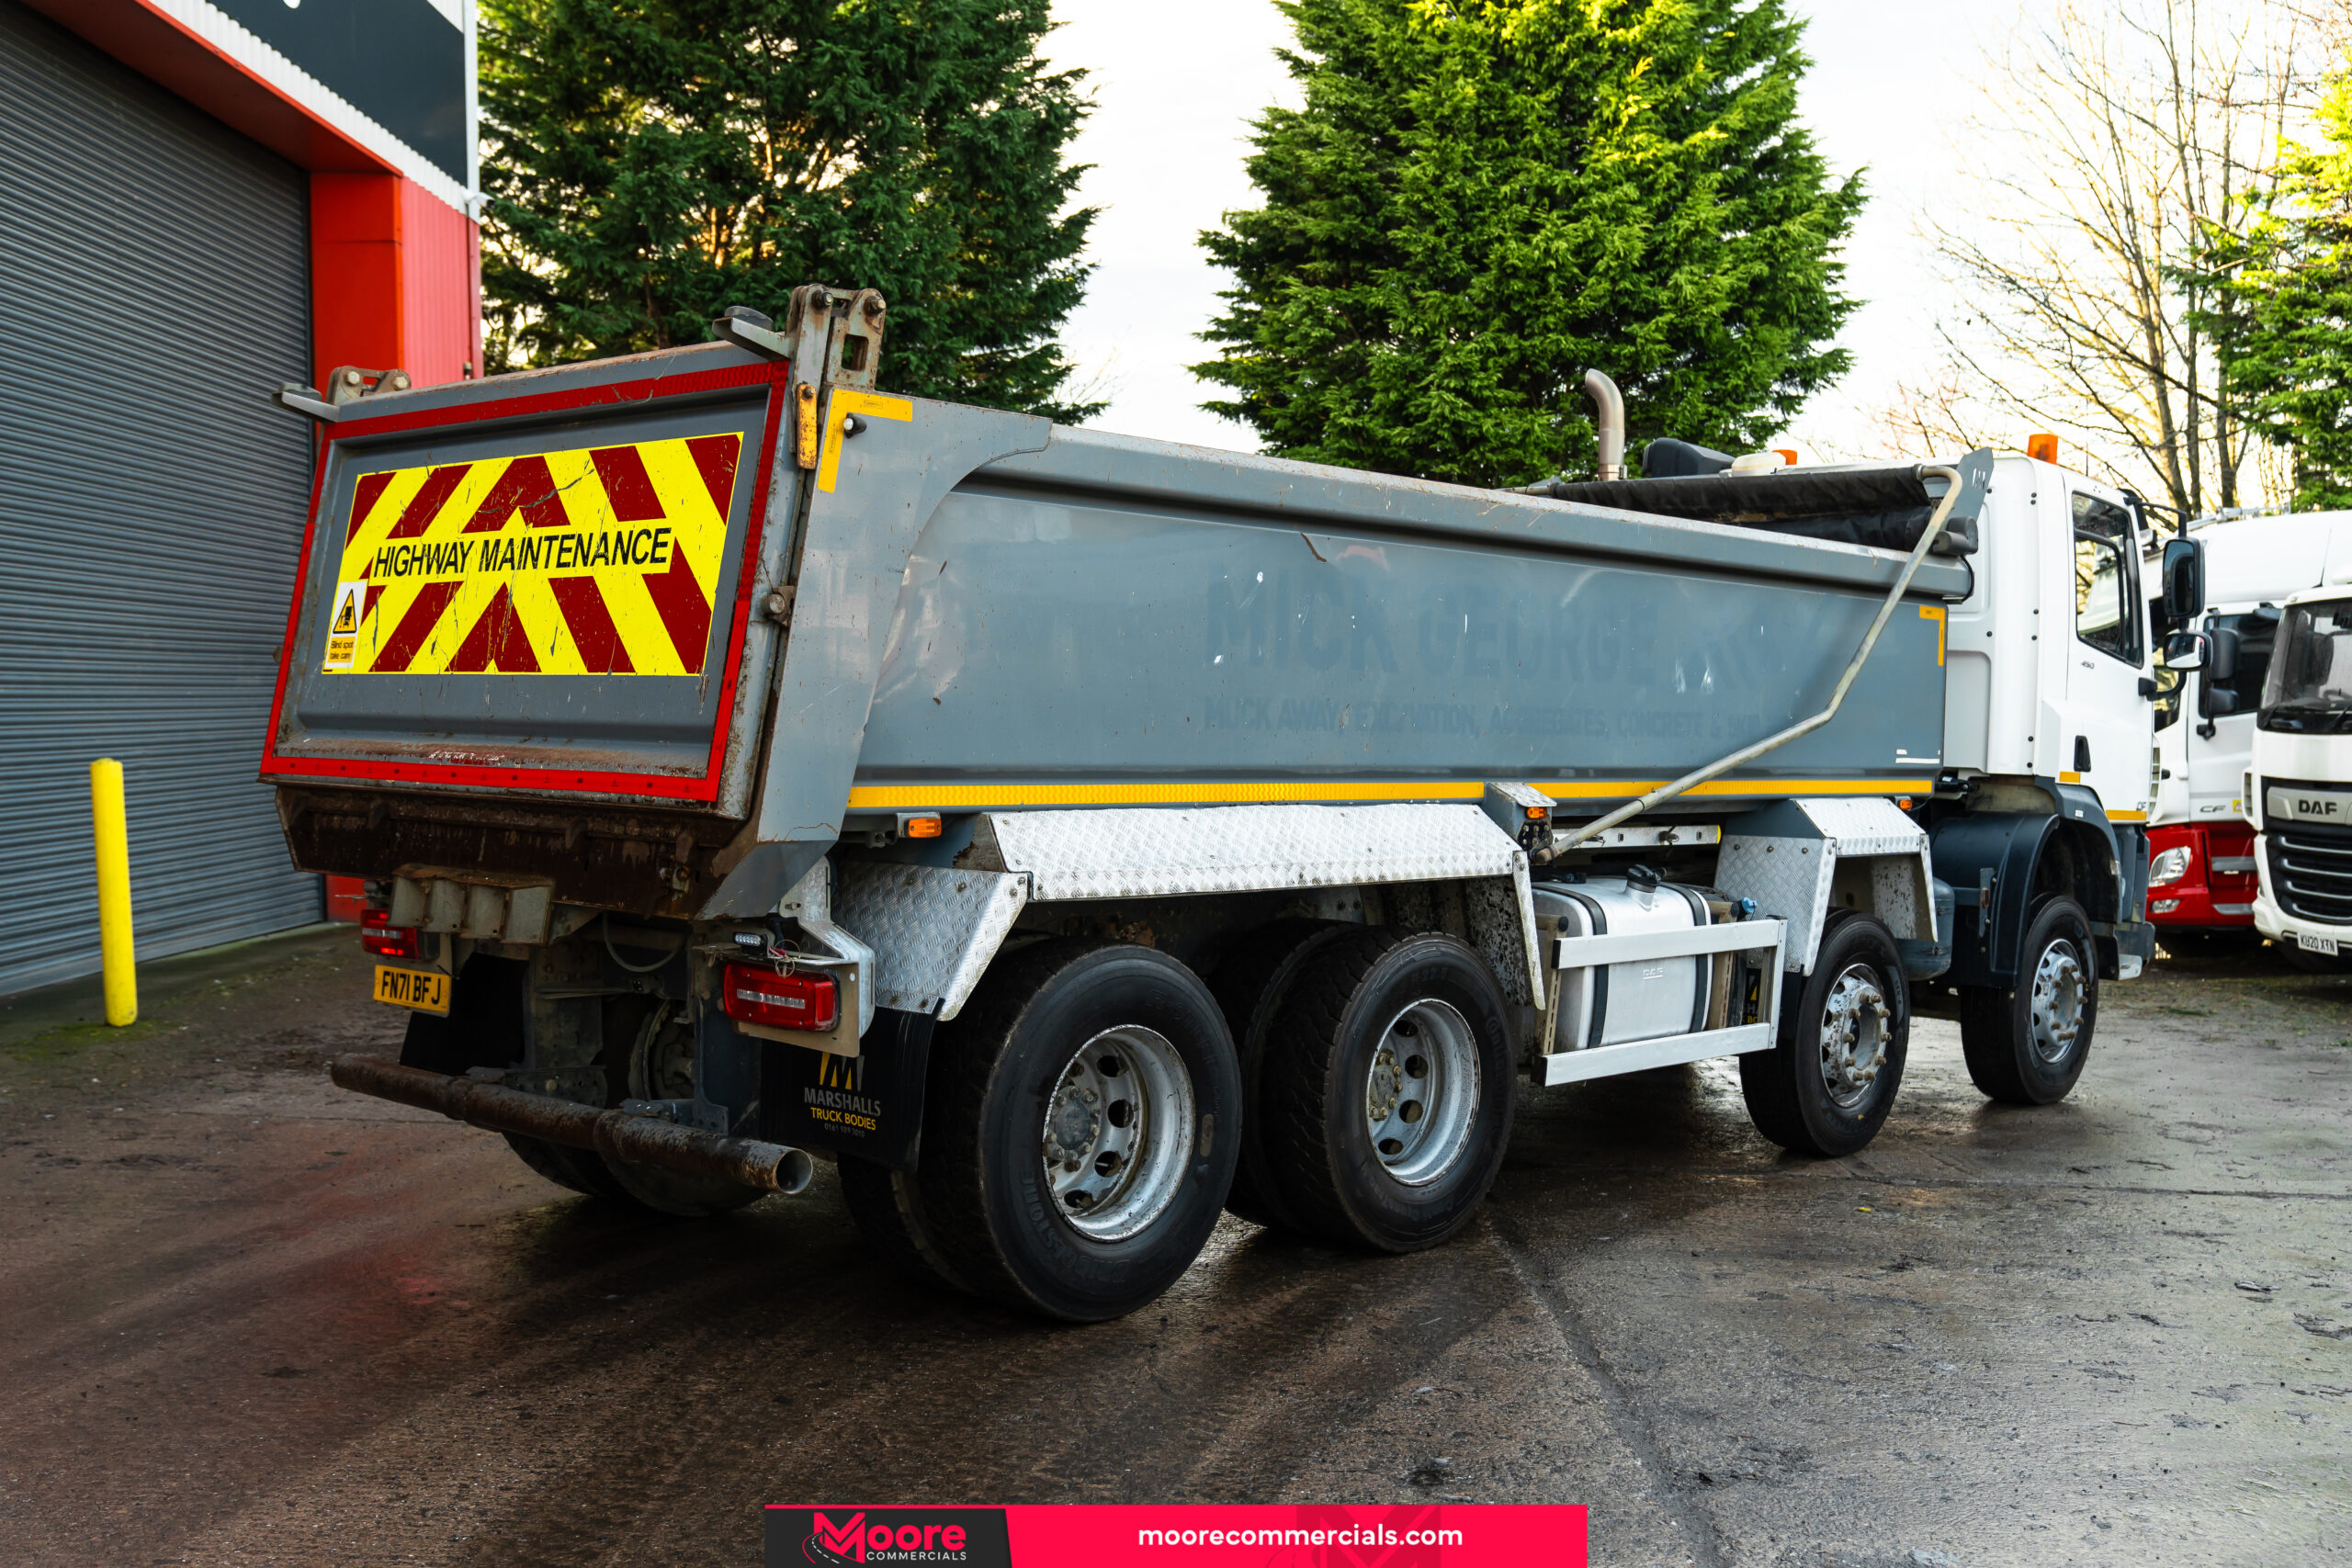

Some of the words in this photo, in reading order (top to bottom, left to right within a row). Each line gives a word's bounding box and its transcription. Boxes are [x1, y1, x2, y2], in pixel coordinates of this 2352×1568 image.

[373, 540, 475, 578] HIGHWAY
[479, 527, 673, 573] MAINTENANCE
[1204, 696, 1271, 730] MUCK
[2199, 805, 2226, 813] CF
[2299, 799, 2337, 815] DAF
[381, 970, 411, 1000] FN71
[413, 975, 441, 1005] BFJ
[804, 1087, 882, 1117] MARSHALLS
[809, 1107, 842, 1123] TRUCK
[844, 1112, 876, 1131] BODIES
